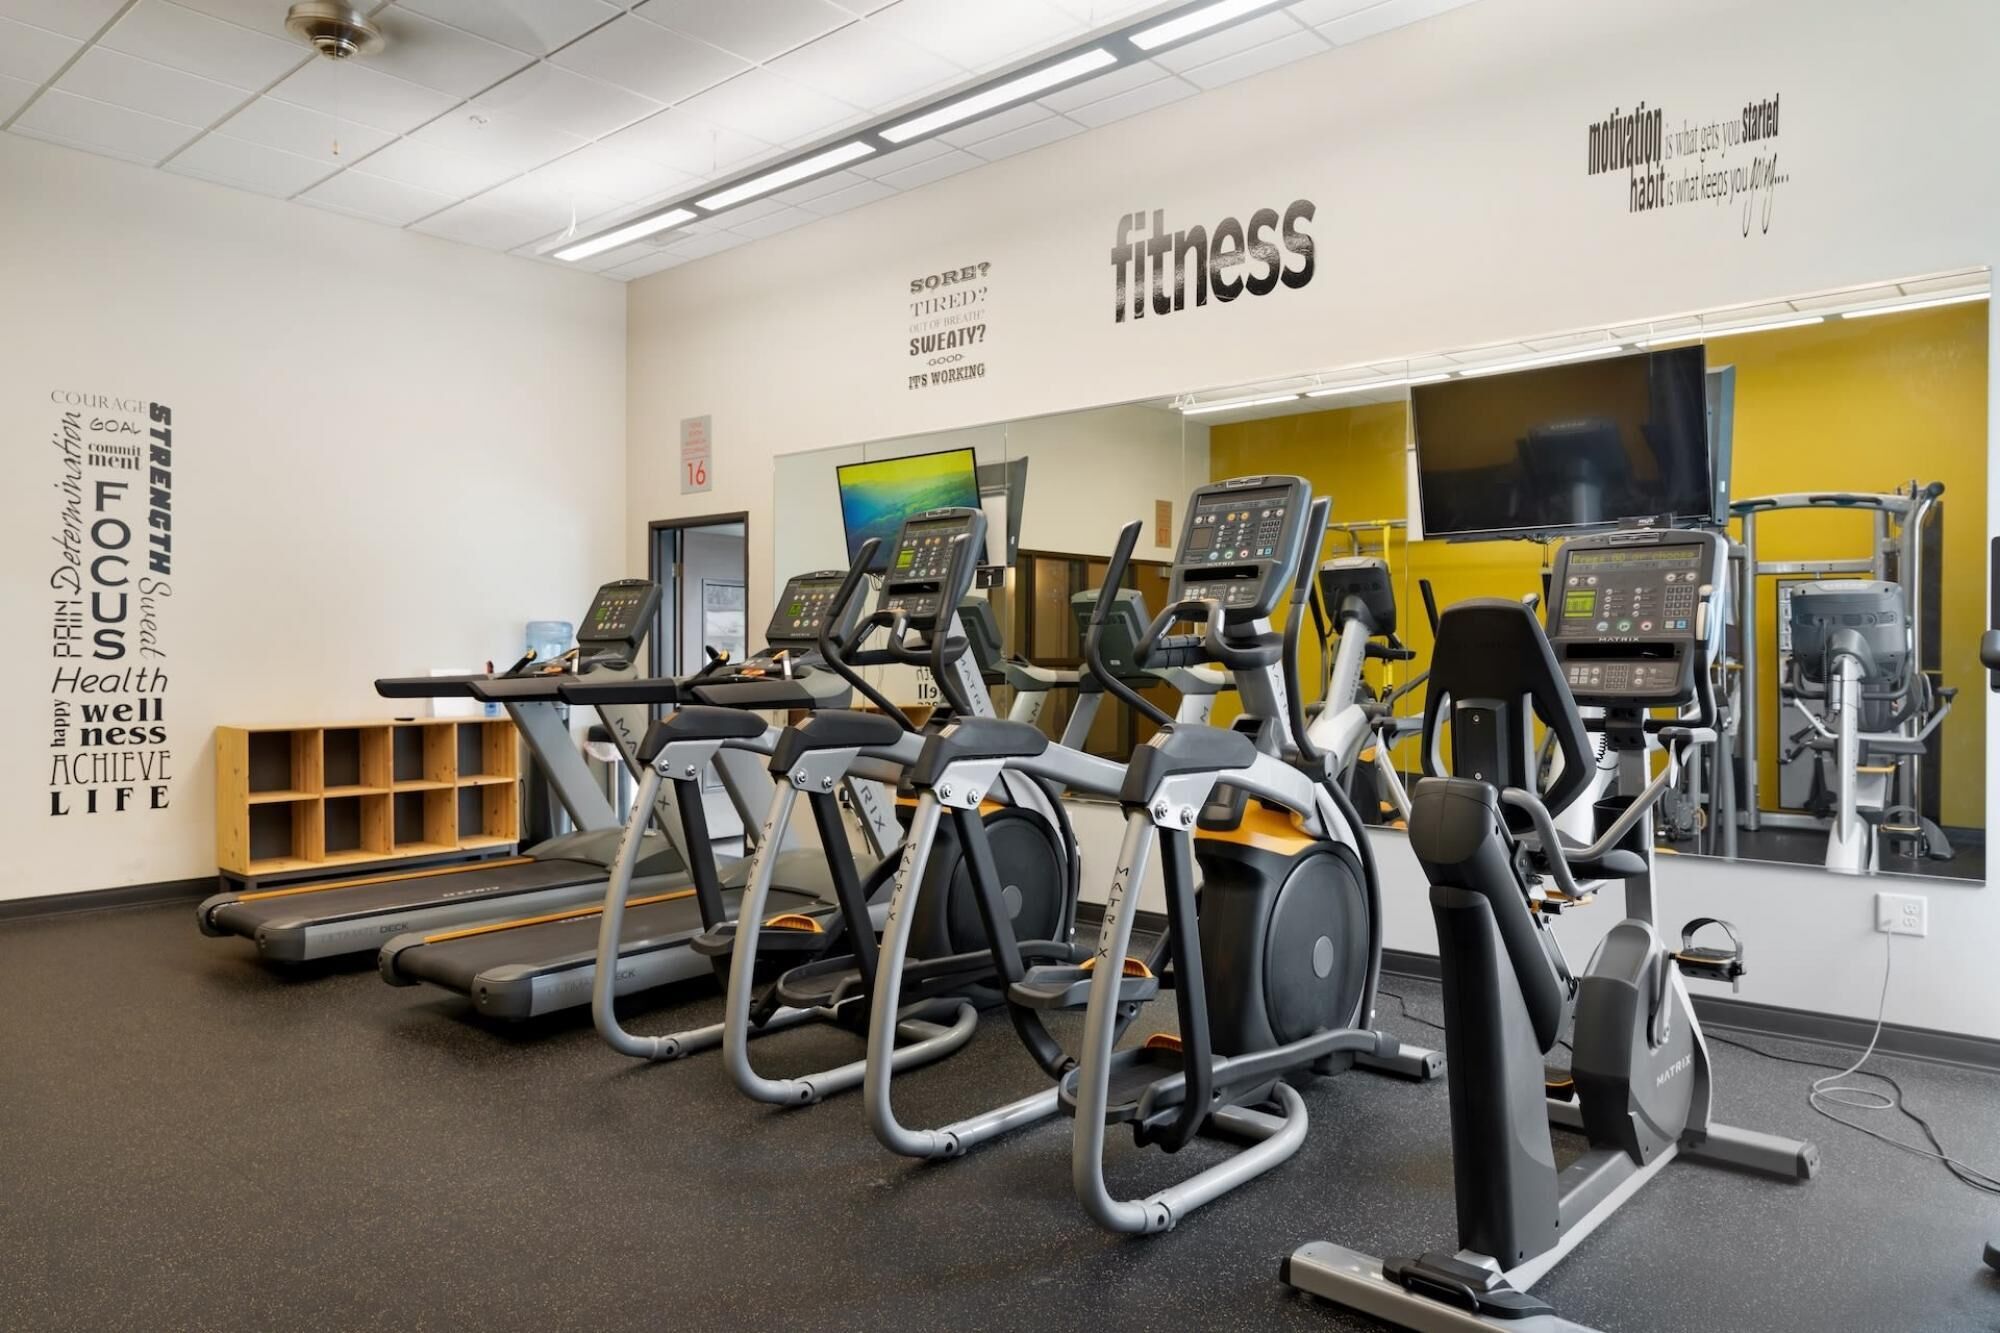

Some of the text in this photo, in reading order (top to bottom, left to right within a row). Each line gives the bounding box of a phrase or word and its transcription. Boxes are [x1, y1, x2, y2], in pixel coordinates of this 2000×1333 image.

[1588, 92, 1779, 175] motivation is what gets you started
[1629, 160, 1665, 213] habit
[1667, 173, 1674, 206] is
[1676, 168, 1699, 204] what
[1701, 163, 1728, 206] keeps
[1730, 166, 1748, 205] you
[910, 261, 991, 294] SORE?
[1111, 199, 1316, 323] fitness
[910, 286, 988, 317] TIRED?
[910, 324, 986, 356] SWEATY?
[931, 363, 985, 385] WORKING
[50, 389, 147, 414] COURAGE
[90, 417, 141, 434] GOAL
[88, 442, 141, 457] commit
[88, 453, 141, 471] ment
[149, 402, 171, 576] STRENGTH
[688, 459, 706, 486] 16
[50, 411, 83, 595] Determination
[91, 481, 132, 660] FOCUS
[53, 601, 83, 658] PAIN
[138, 577, 172, 660] Sweat
[52, 666, 168, 693] Health
[50, 699, 71, 747] happy
[80, 698, 163, 722] well
[80, 726, 167, 746] ness
[50, 750, 171, 785] ACHIEVE
[50, 785, 170, 816] LIFE
[1098, 866, 1129, 959] MATRIX
[1656, 1053, 1691, 1088] MATRIX
